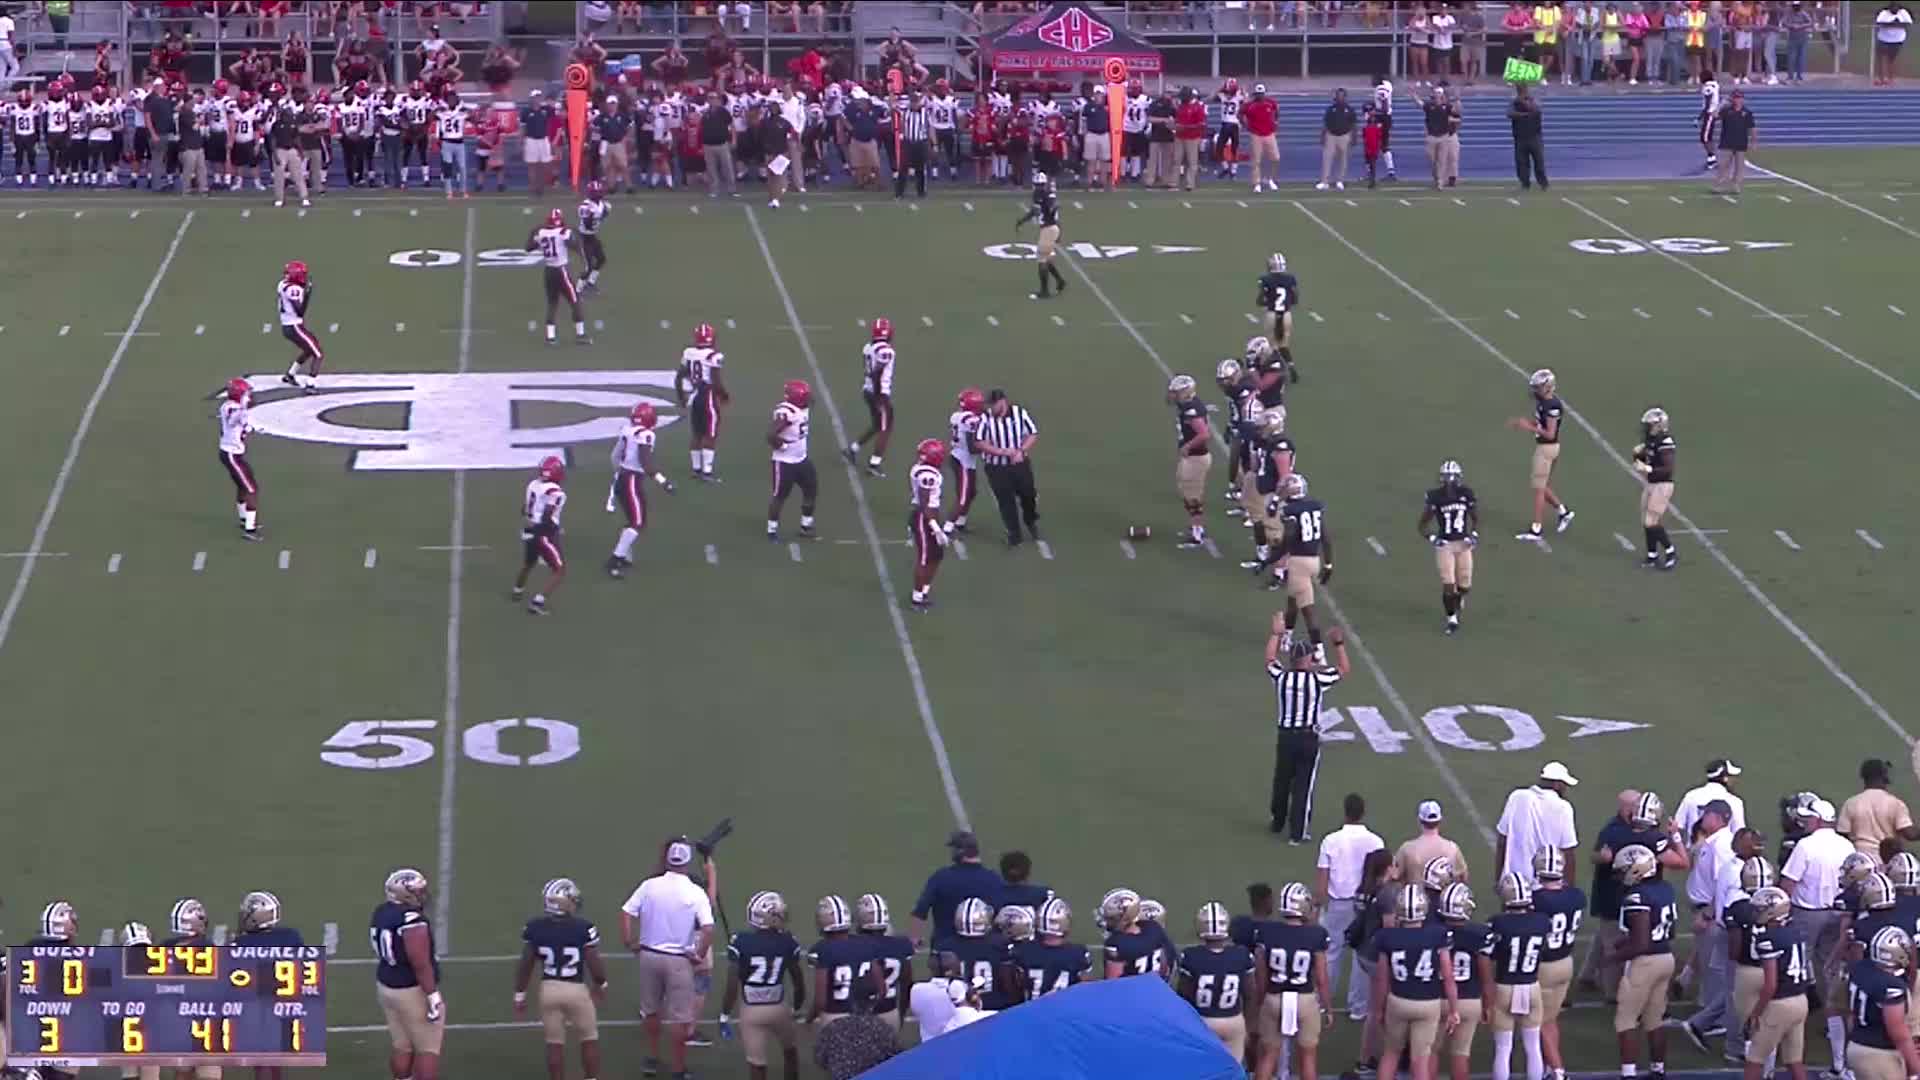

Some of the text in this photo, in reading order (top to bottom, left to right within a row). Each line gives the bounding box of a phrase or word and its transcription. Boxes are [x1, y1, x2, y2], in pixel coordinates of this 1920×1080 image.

[1039, 8, 1113, 52] CHS
[539, 237, 559, 258] 21
[1274, 286, 1286, 312] 2
[1299, 510, 1321, 543] 85
[1443, 509, 1465, 535] 14
[320, 717, 582, 769] 50
[538, 946, 579, 978] 22
[748, 956, 780, 985] 21
[1269, 948, 1310, 985] 99
[1508, 936, 1543, 973] 16
[1197, 975, 1239, 1009] 68
